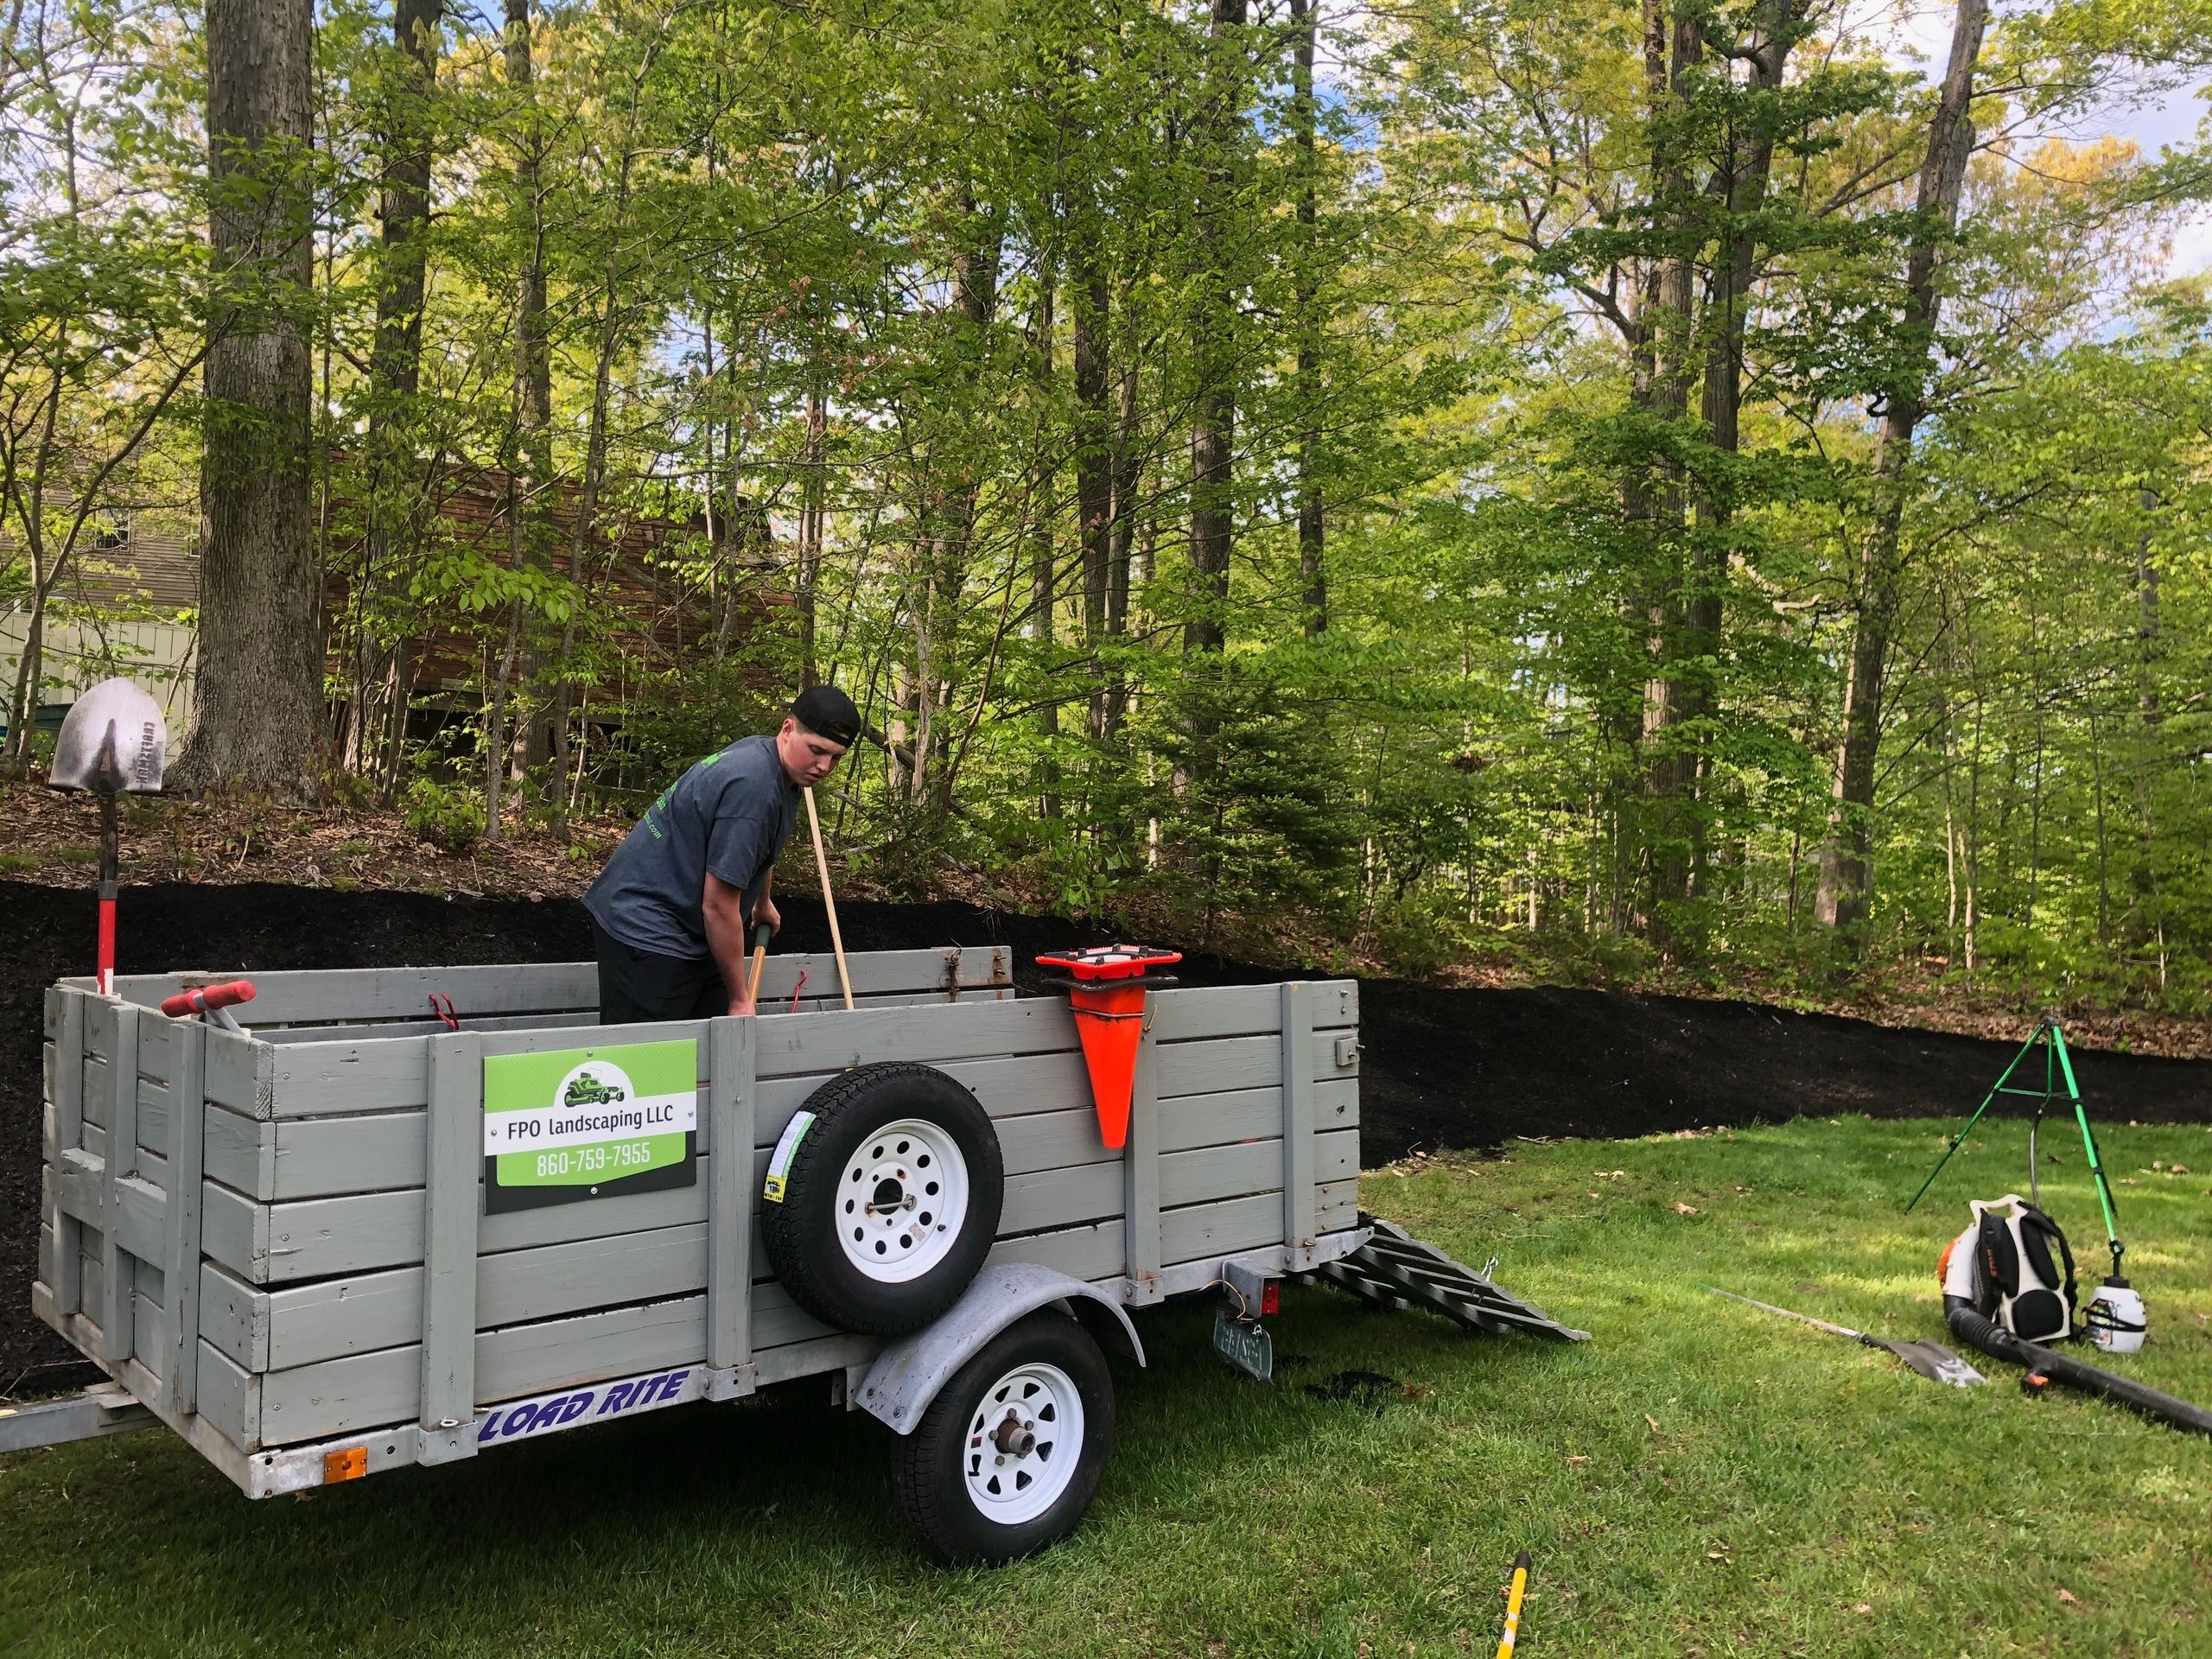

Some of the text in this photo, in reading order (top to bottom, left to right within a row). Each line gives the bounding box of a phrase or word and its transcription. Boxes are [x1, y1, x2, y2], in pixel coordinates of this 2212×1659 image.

[508, 1104, 674, 1140] FPO landscaping LLC
[537, 1142, 651, 1177] 860-759-7955
[478, 1370, 690, 1442] LOAD RITE
